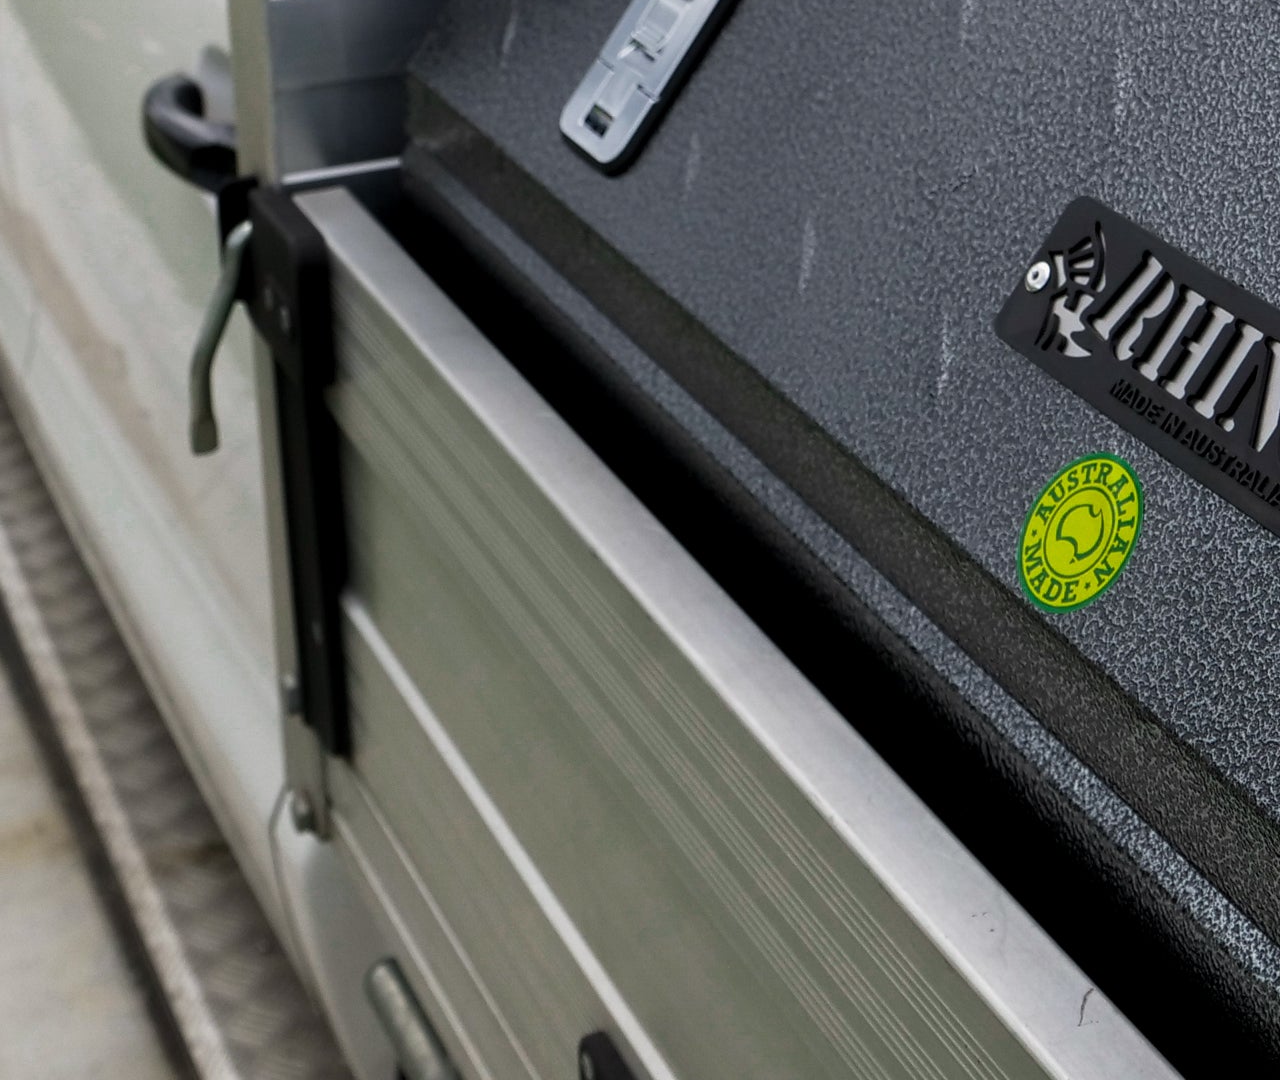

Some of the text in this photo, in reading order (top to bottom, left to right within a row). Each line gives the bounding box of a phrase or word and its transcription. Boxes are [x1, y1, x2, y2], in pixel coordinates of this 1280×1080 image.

[1110, 378, 1166, 425] MADE
[1160, 411, 1186, 439] IN
[1036, 462, 1135, 587] AUSTRALIAN
[1025, 538, 1080, 603] MADE
